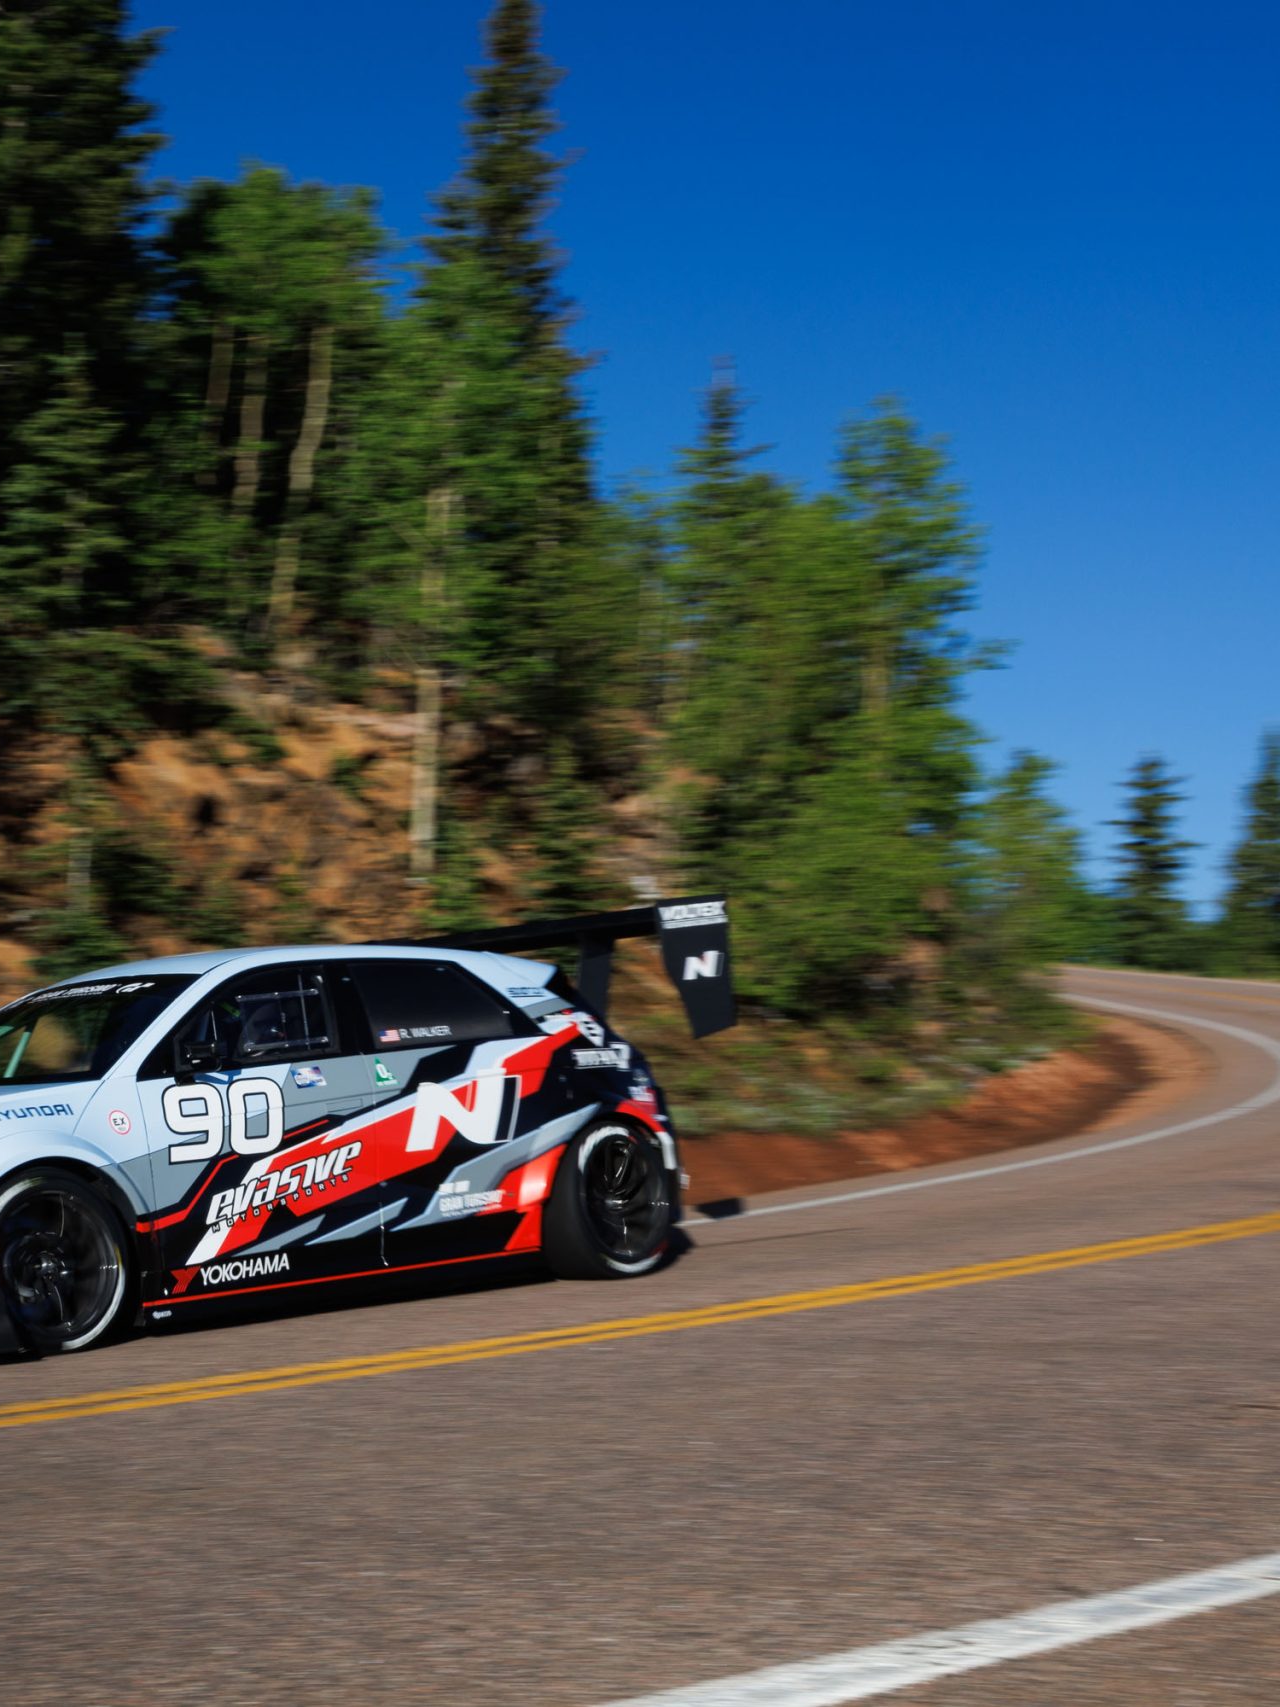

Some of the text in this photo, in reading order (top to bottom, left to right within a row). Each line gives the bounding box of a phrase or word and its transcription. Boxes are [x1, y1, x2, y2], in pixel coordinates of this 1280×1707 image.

[410, 1025, 452, 1038] WALKER
[162, 1077, 285, 1165] 90
[211, 1172, 350, 1233] MOTORSPORTS
[200, 1252, 290, 1286] YOKOHAMA
